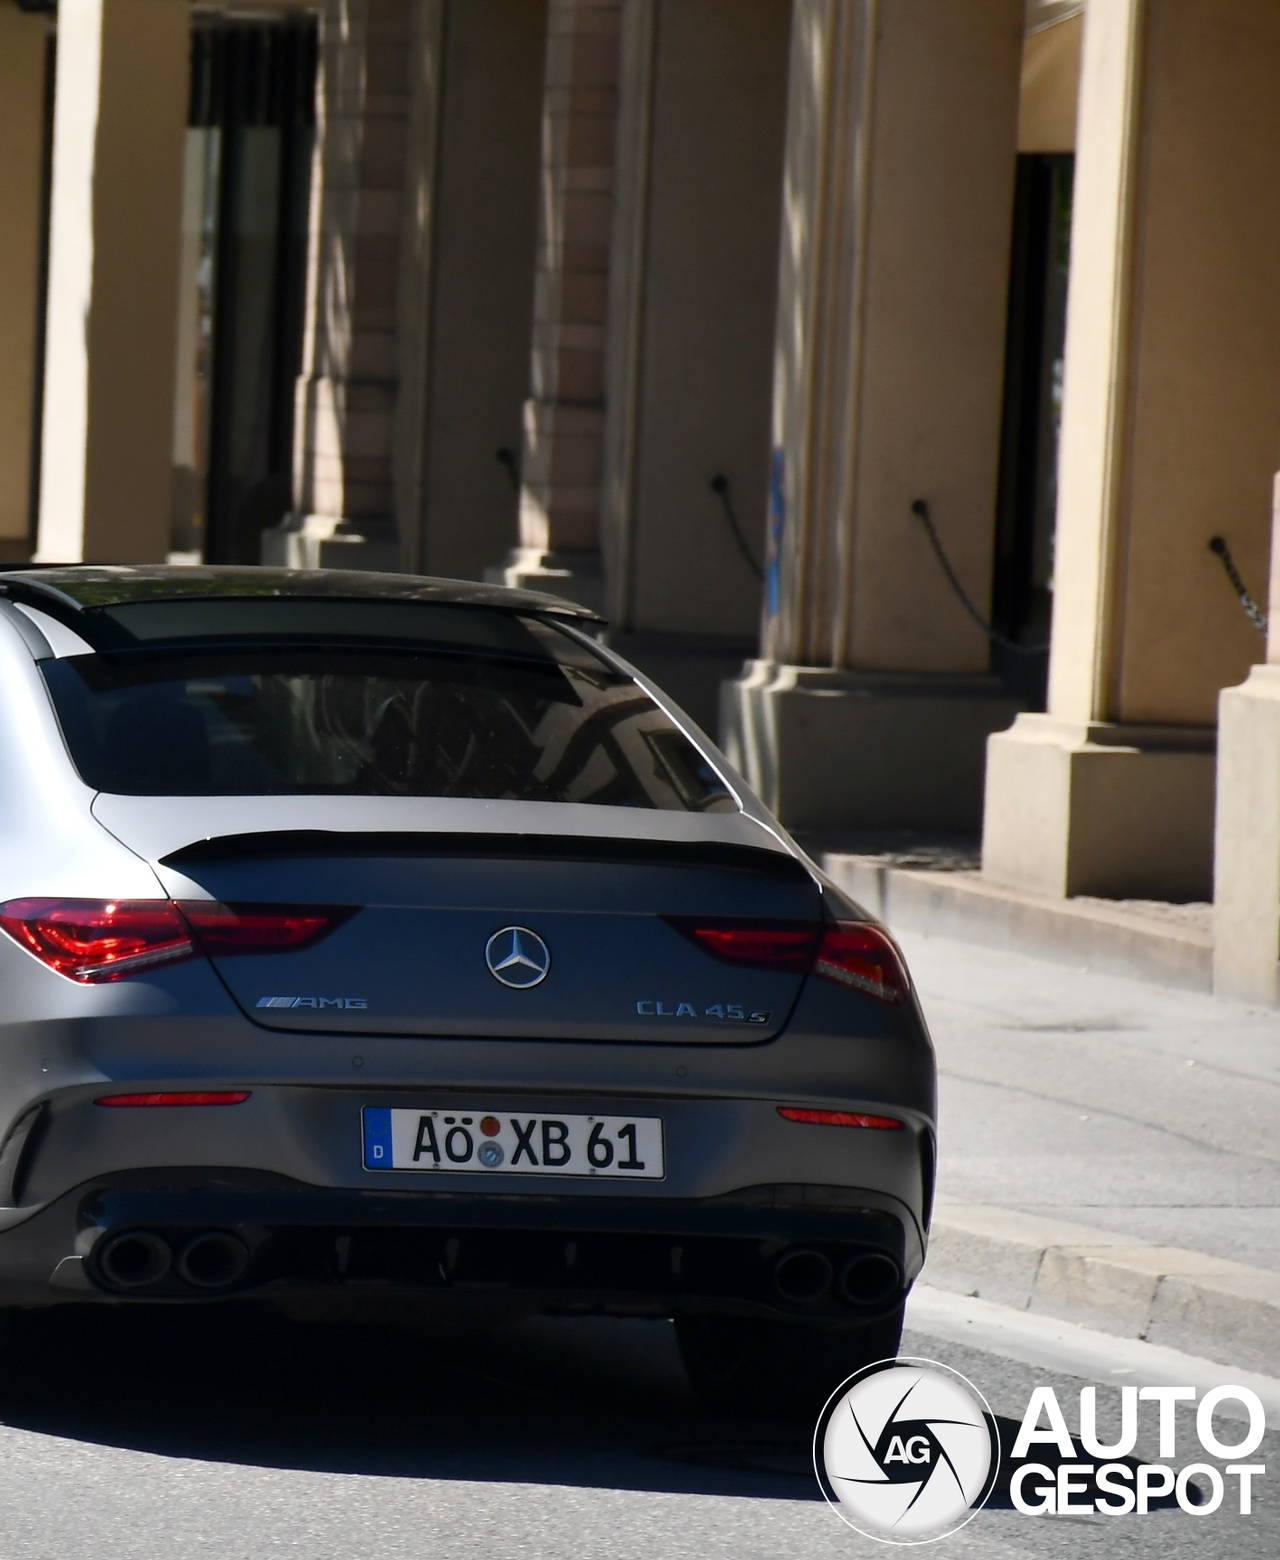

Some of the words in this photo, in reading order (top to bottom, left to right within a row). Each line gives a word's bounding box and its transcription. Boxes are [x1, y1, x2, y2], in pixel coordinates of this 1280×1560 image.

[293, 997, 368, 1010] AMG
[636, 1000, 698, 1018] CLA
[412, 1115, 474, 1164] AÖ
[509, 1118, 572, 1167] XB
[586, 1122, 646, 1171] 61
[373, 1145, 384, 1159] D
